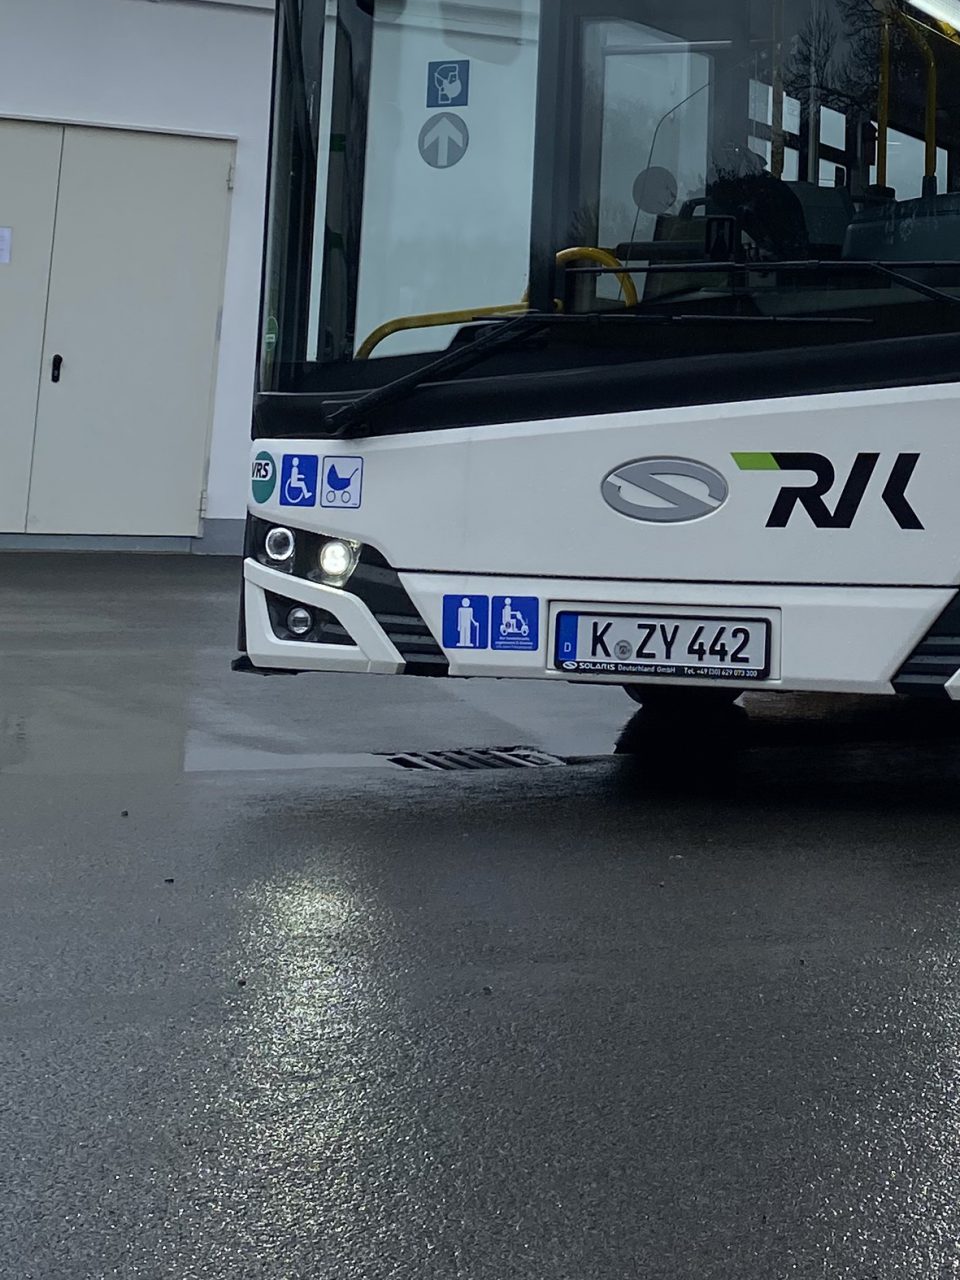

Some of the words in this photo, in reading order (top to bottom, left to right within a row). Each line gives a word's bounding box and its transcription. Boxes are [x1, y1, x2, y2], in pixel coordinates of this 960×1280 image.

[251, 462, 270, 479] VRS
[731, 452, 925, 529] RVK
[563, 642, 572, 653] D
[591, 621, 613, 658] K
[635, 623, 680, 660] ZY
[687, 626, 751, 664] 442
[578, 662, 615, 671] SOLARIS
[618, 664, 655, 673] Deutschland
[657, 666, 676, 674] GmbH
